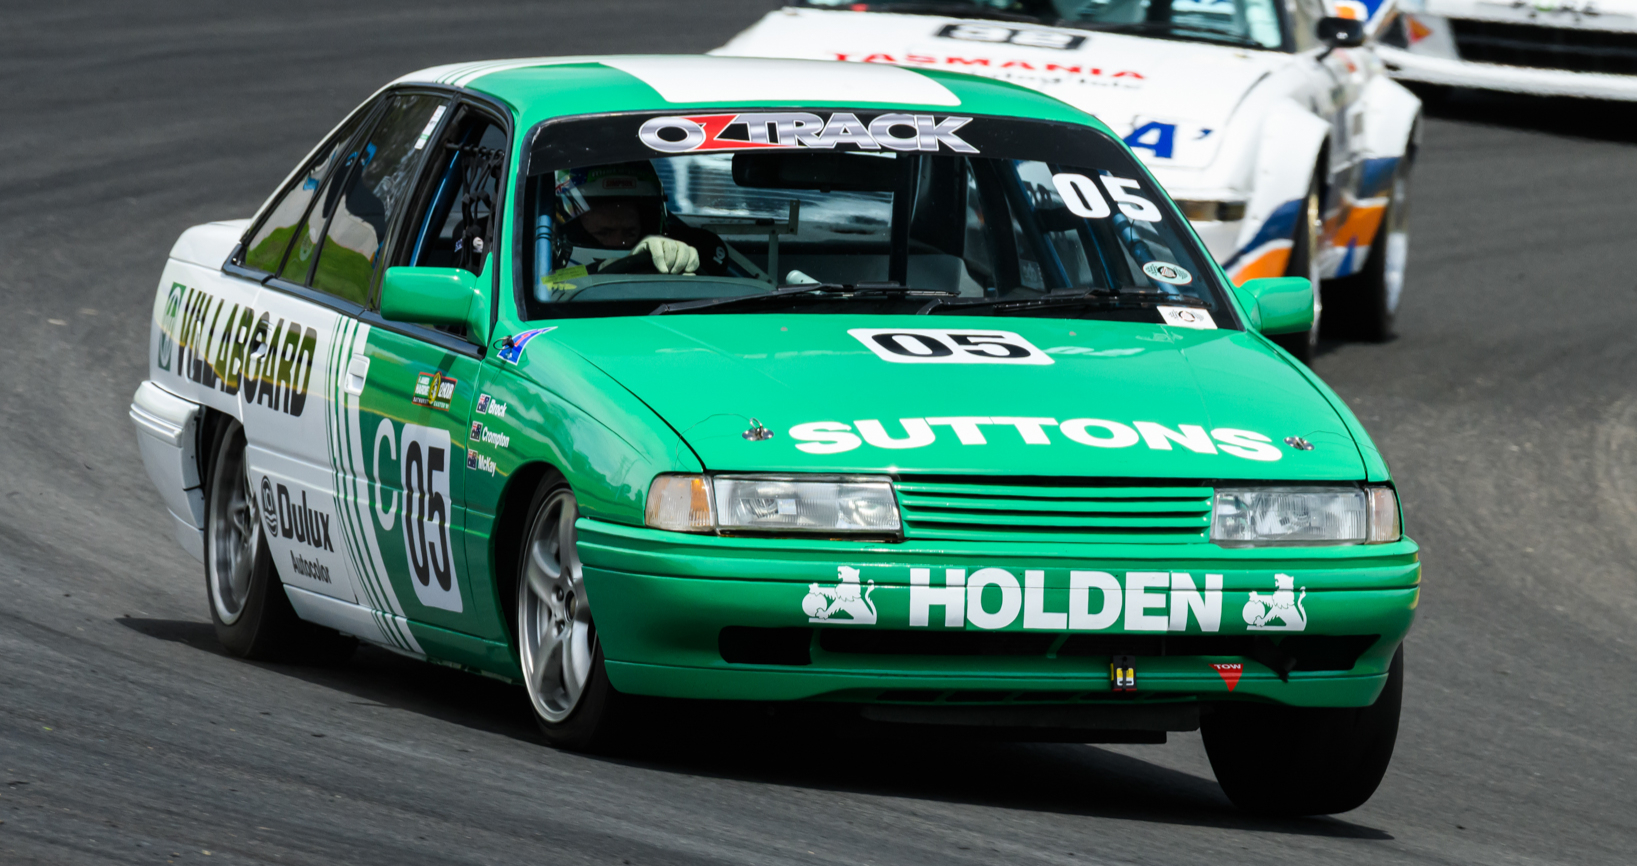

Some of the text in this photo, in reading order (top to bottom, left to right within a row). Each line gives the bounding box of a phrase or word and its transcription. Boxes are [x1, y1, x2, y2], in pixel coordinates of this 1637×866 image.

[834, 53, 1145, 79] TASMANIA
[1052, 173, 1162, 222] 05
[177, 288, 317, 417] VILLABOARD
[869, 329, 1034, 358] 05
[488, 398, 507, 417] Brock
[482, 426, 510, 449] Crompton
[788, 416, 1283, 462] SUTTONS
[478, 454, 497, 477] McKay
[277, 483, 334, 553] Dulux
[405, 440, 451, 592] 05
[290, 550, 332, 584] Autocolor
[908, 567, 1225, 633] HOLDEN
